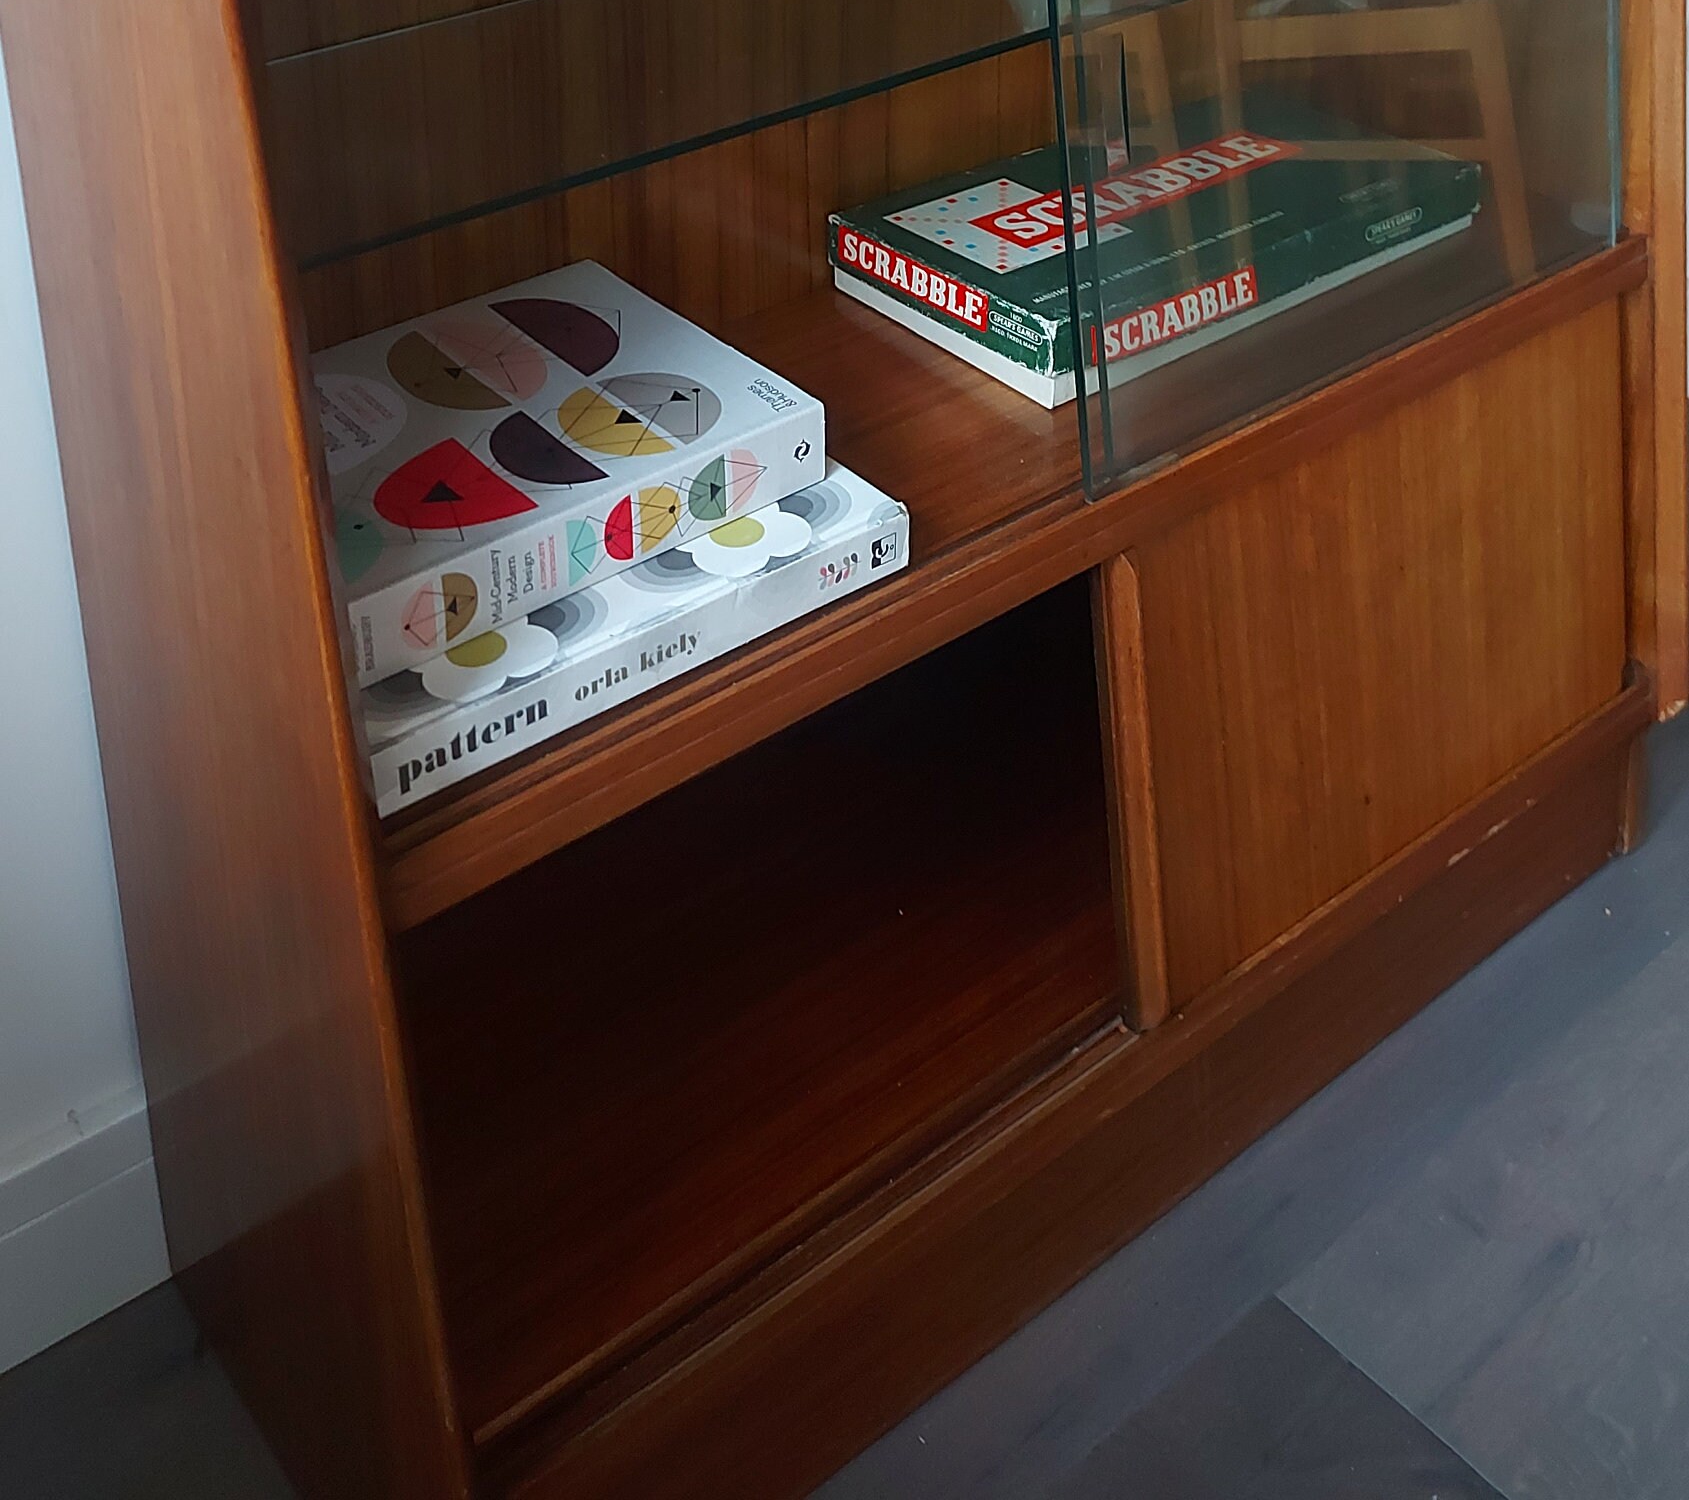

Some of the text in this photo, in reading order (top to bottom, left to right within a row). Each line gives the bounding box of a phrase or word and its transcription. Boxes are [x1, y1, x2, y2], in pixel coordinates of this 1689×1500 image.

[994, 136, 1281, 239] SCRABBLE
[843, 233, 983, 326] SCRABBLE
[1104, 271, 1253, 358] SCRABBLE
[747, 384, 785, 412] Thames
[506, 555, 518, 604] Modern
[522, 550, 535, 595] Design
[397, 631, 702, 796] pattern orla kiely
